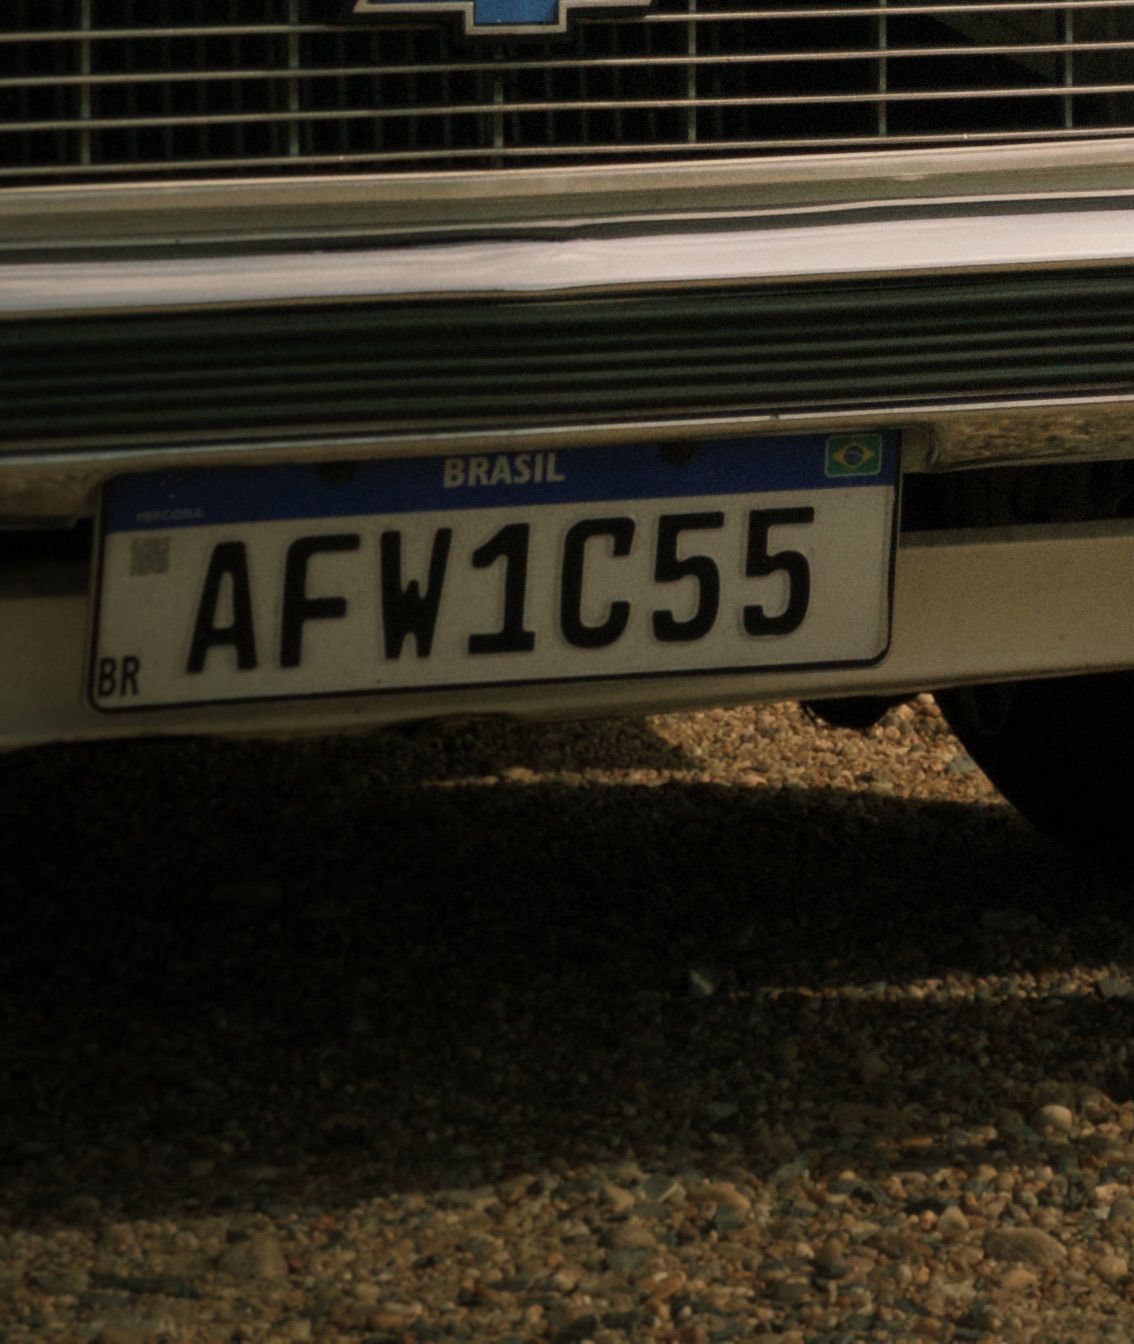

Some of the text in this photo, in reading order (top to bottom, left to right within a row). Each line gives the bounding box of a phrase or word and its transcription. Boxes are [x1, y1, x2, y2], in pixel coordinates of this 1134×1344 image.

[443, 453, 567, 488] BRASIL
[186, 506, 815, 673] AFW1C55
[98, 656, 140, 696] BR
